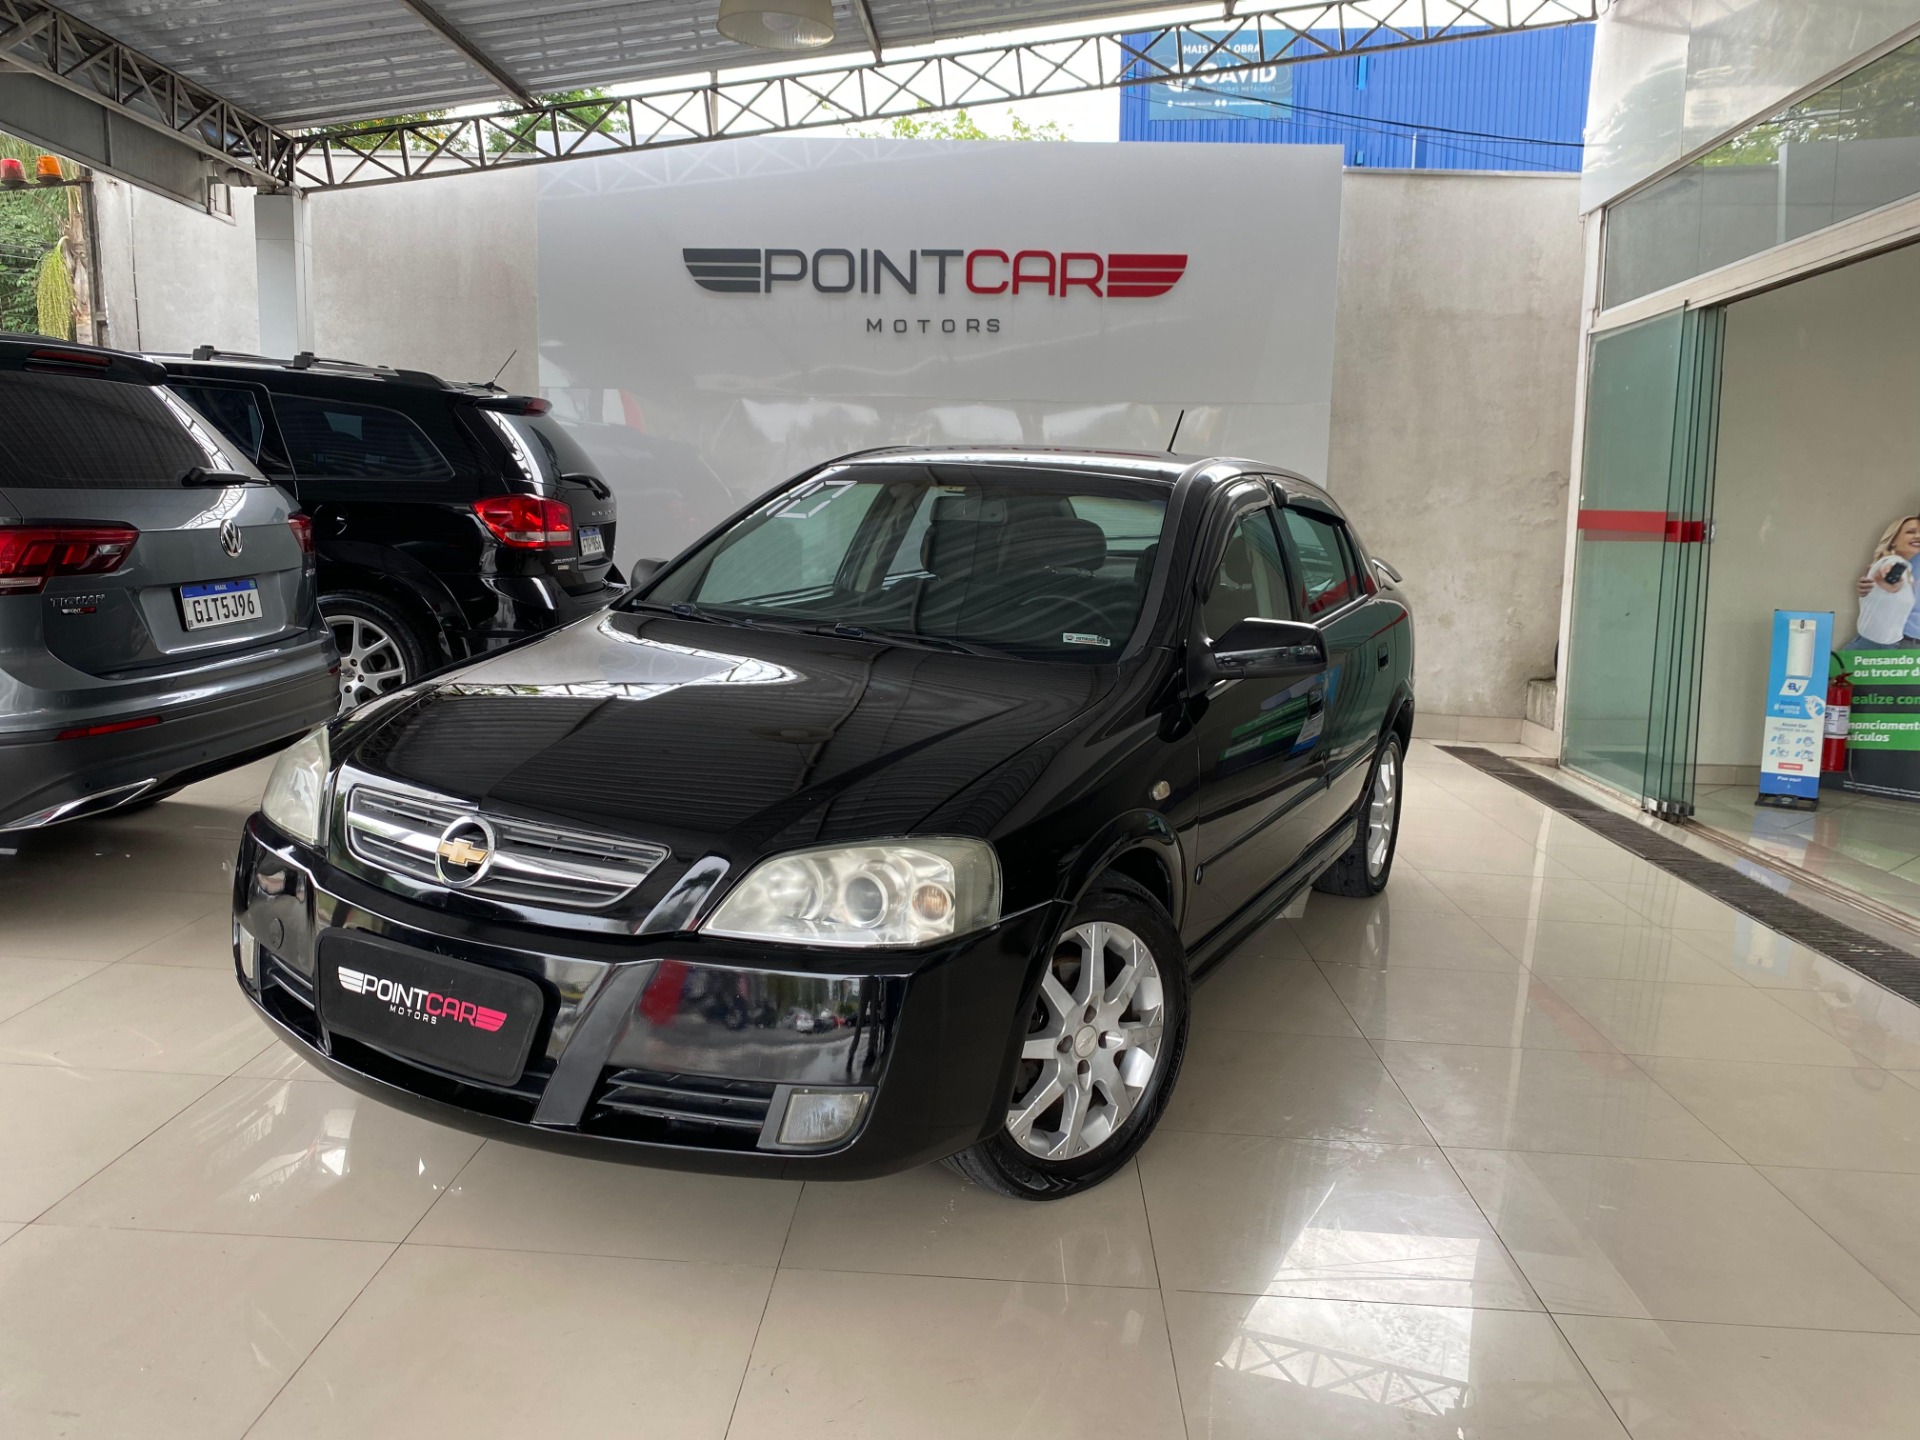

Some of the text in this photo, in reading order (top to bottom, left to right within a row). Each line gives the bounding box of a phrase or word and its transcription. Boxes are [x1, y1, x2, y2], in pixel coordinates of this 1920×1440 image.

[1183, 44, 1208, 54] MAIS
[1233, 43, 1260, 53] OBRA
[764, 248, 1104, 297] POINTCAR
[866, 318, 1001, 334] MOTORS
[192, 592, 255, 624] GIT5J96
[1854, 655, 1914, 666] Pensando
[1854, 667, 1920, 677] ou trocar d
[1852, 694, 1894, 705] ealize
[361, 973, 477, 1028] POINTCAR
[389, 1004, 437, 1025] MOTORS
